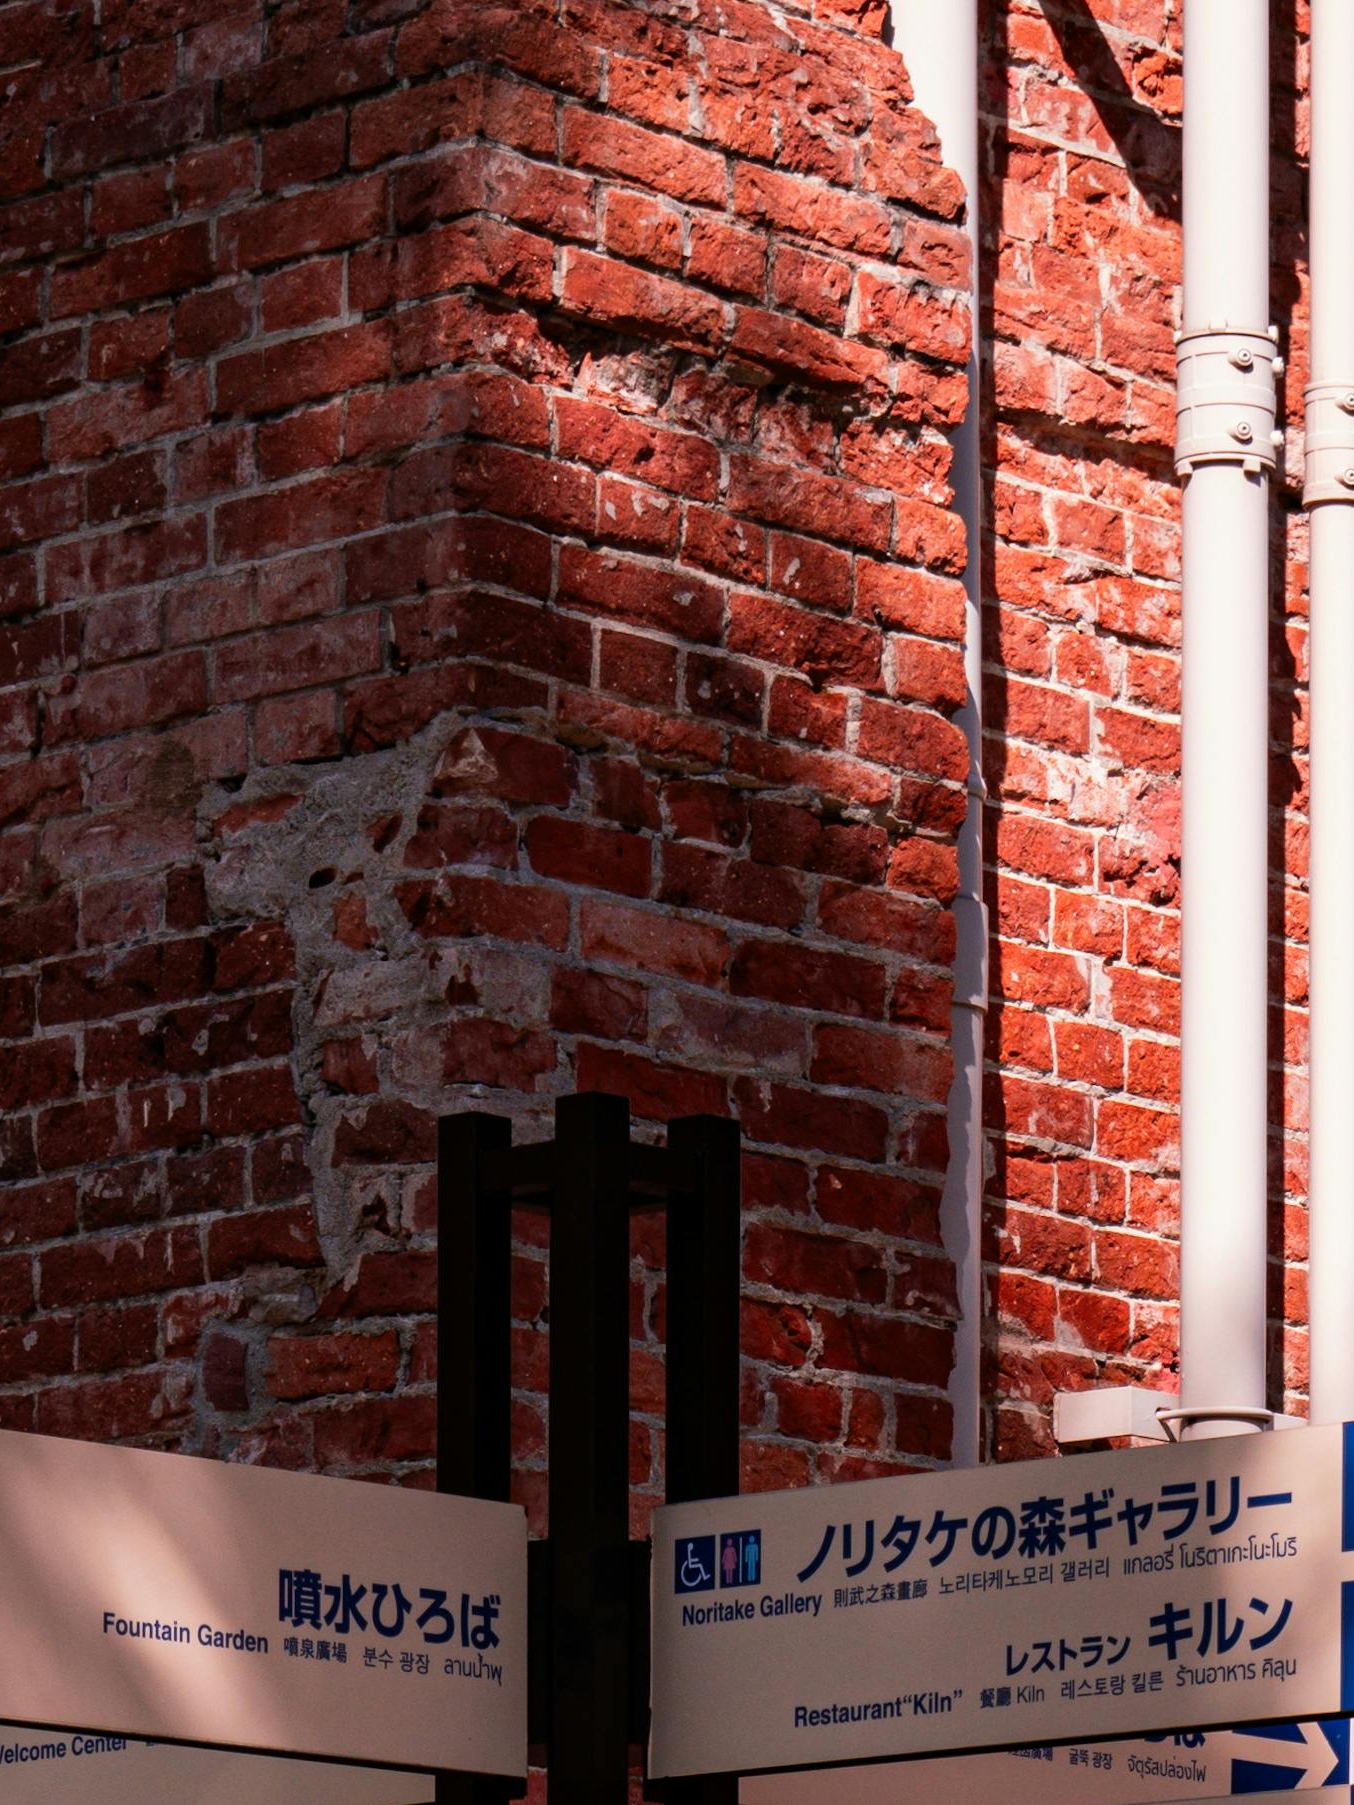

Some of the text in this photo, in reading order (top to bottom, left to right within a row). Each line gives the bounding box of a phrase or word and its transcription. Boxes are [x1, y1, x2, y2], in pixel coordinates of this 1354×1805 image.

[797, 1476, 1293, 1582] ノリタケの森ギャラリー
[278, 1568, 502, 1650] 噴水ひろば
[682, 1594, 823, 1626] Noritake Gallery
[102, 1612, 269, 1654] Fountain Garden
[1006, 1598, 1293, 1676] レストラン キルン
[283, 1637, 348, 1664] 噴泉廣場
[362, 1646, 431, 1676] 분수 광장
[1016, 1685, 1046, 1704] Kiln
[1060, 1671, 1165, 1701] 레스토랑 킬른
[71, 1735, 128, 1756] Center
